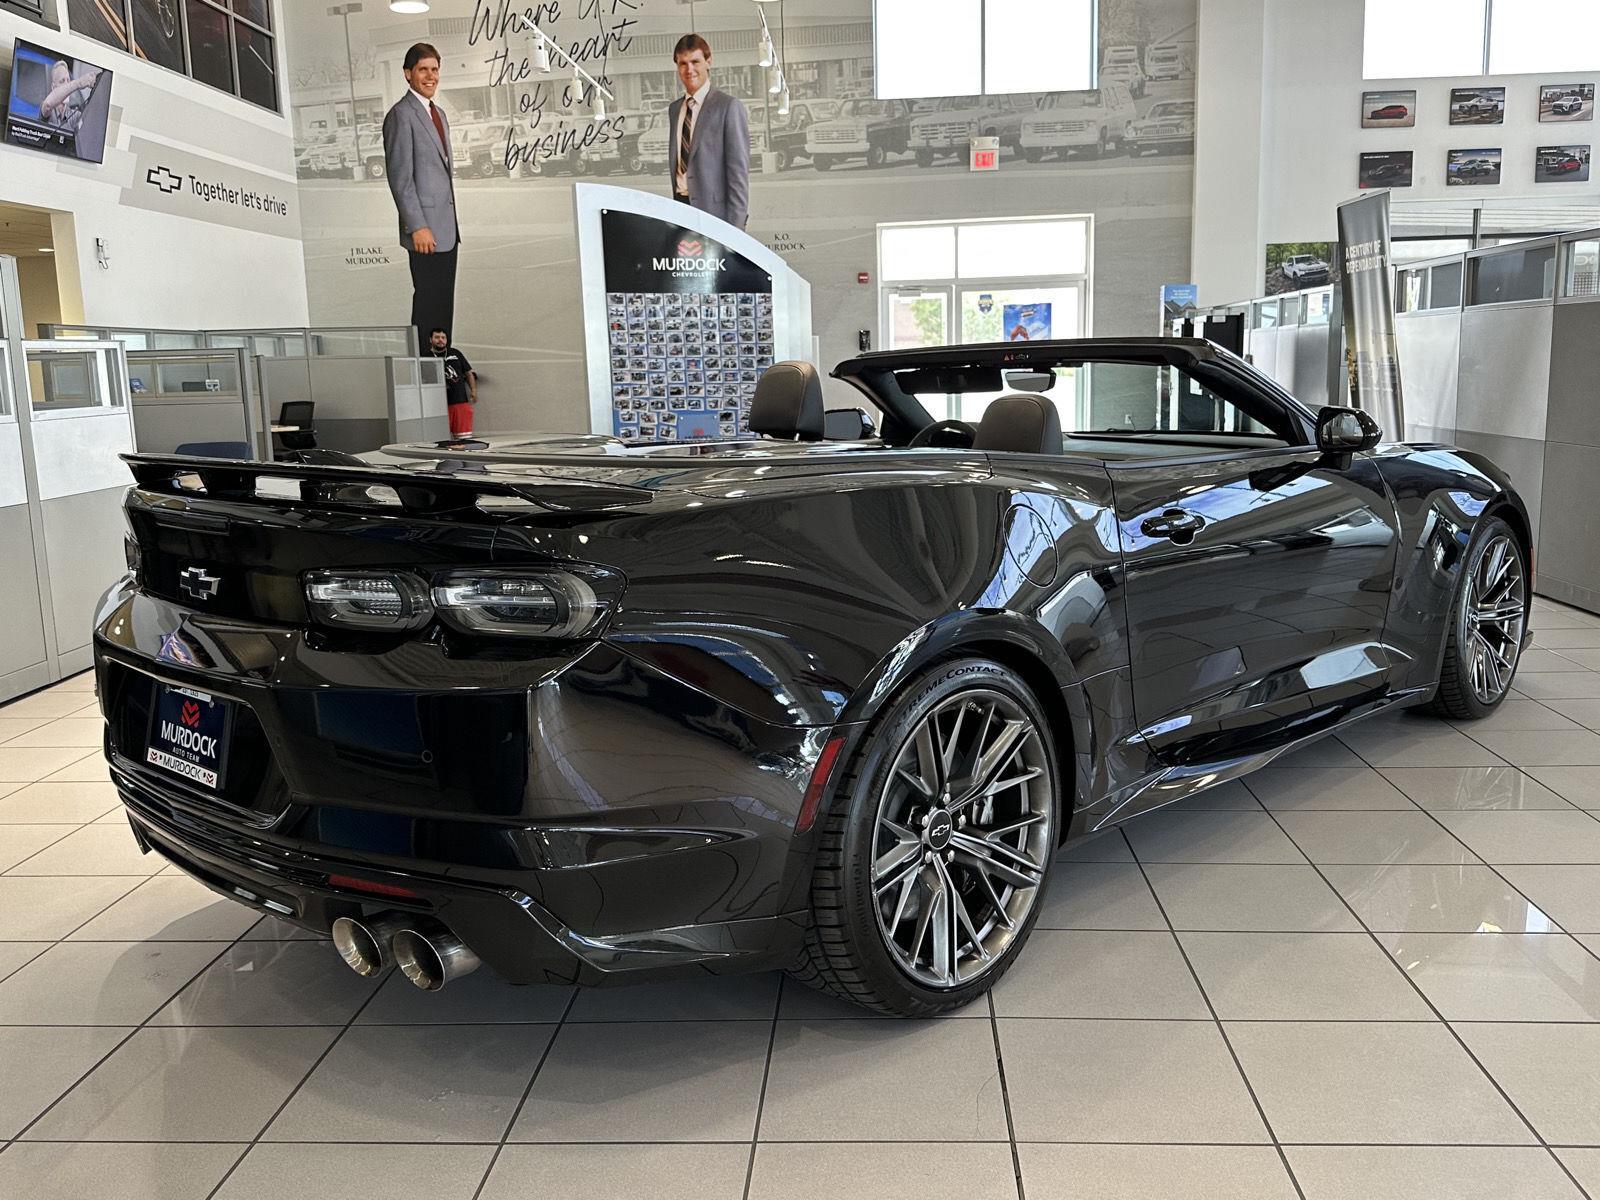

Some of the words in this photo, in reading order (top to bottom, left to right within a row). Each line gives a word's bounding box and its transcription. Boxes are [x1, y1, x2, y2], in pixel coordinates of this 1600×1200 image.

[468, 0, 561, 46] Where
[485, 48, 531, 88] the
[548, 18, 638, 69] heart
[519, 83, 548, 129] of
[562, 76, 613, 108] our
[504, 115, 626, 170] business
[975, 151, 995, 168] EXIT
[188, 174, 239, 205] Together
[240, 187, 262, 210] let's
[263, 194, 288, 216] drive
[356, 247, 383, 255] BLAKE
[765, 242, 806, 251] URDOCK
[1345, 246, 1350, 260] A
[1350, 241, 1373, 259] CENTURY
[1373, 239, 1381, 254] OF
[345, 256, 391, 265] MURDOCK
[652, 257, 727, 271] MURDOCK
[161, 719, 217, 759] MURDOCK
[172, 746, 186, 758] AUTO
[186, 751, 200, 763] TEAM
[162, 755, 202, 780] MURDOCK
